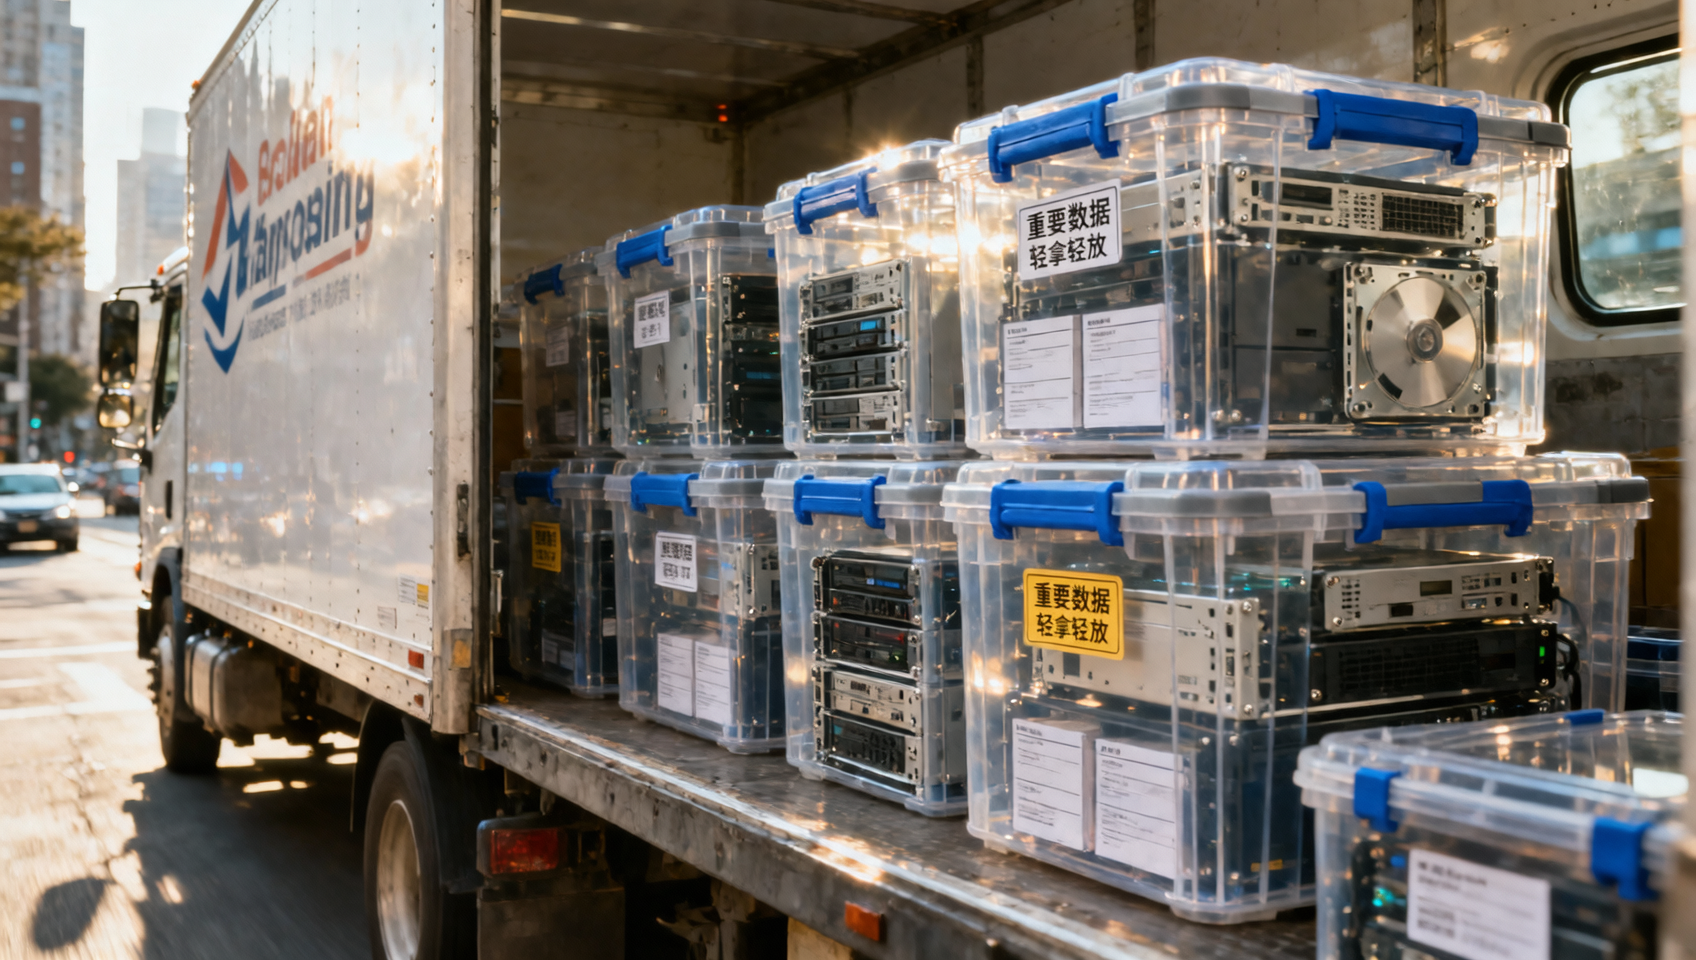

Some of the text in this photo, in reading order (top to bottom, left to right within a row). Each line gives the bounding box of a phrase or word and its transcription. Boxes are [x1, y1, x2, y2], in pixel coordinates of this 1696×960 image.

[1027, 197, 1111, 241] 重要数据
[1029, 232, 1107, 270] 轻拿轻放
[1034, 582, 1111, 615] 重要数据
[1036, 613, 1108, 644] 轻拿轻放
